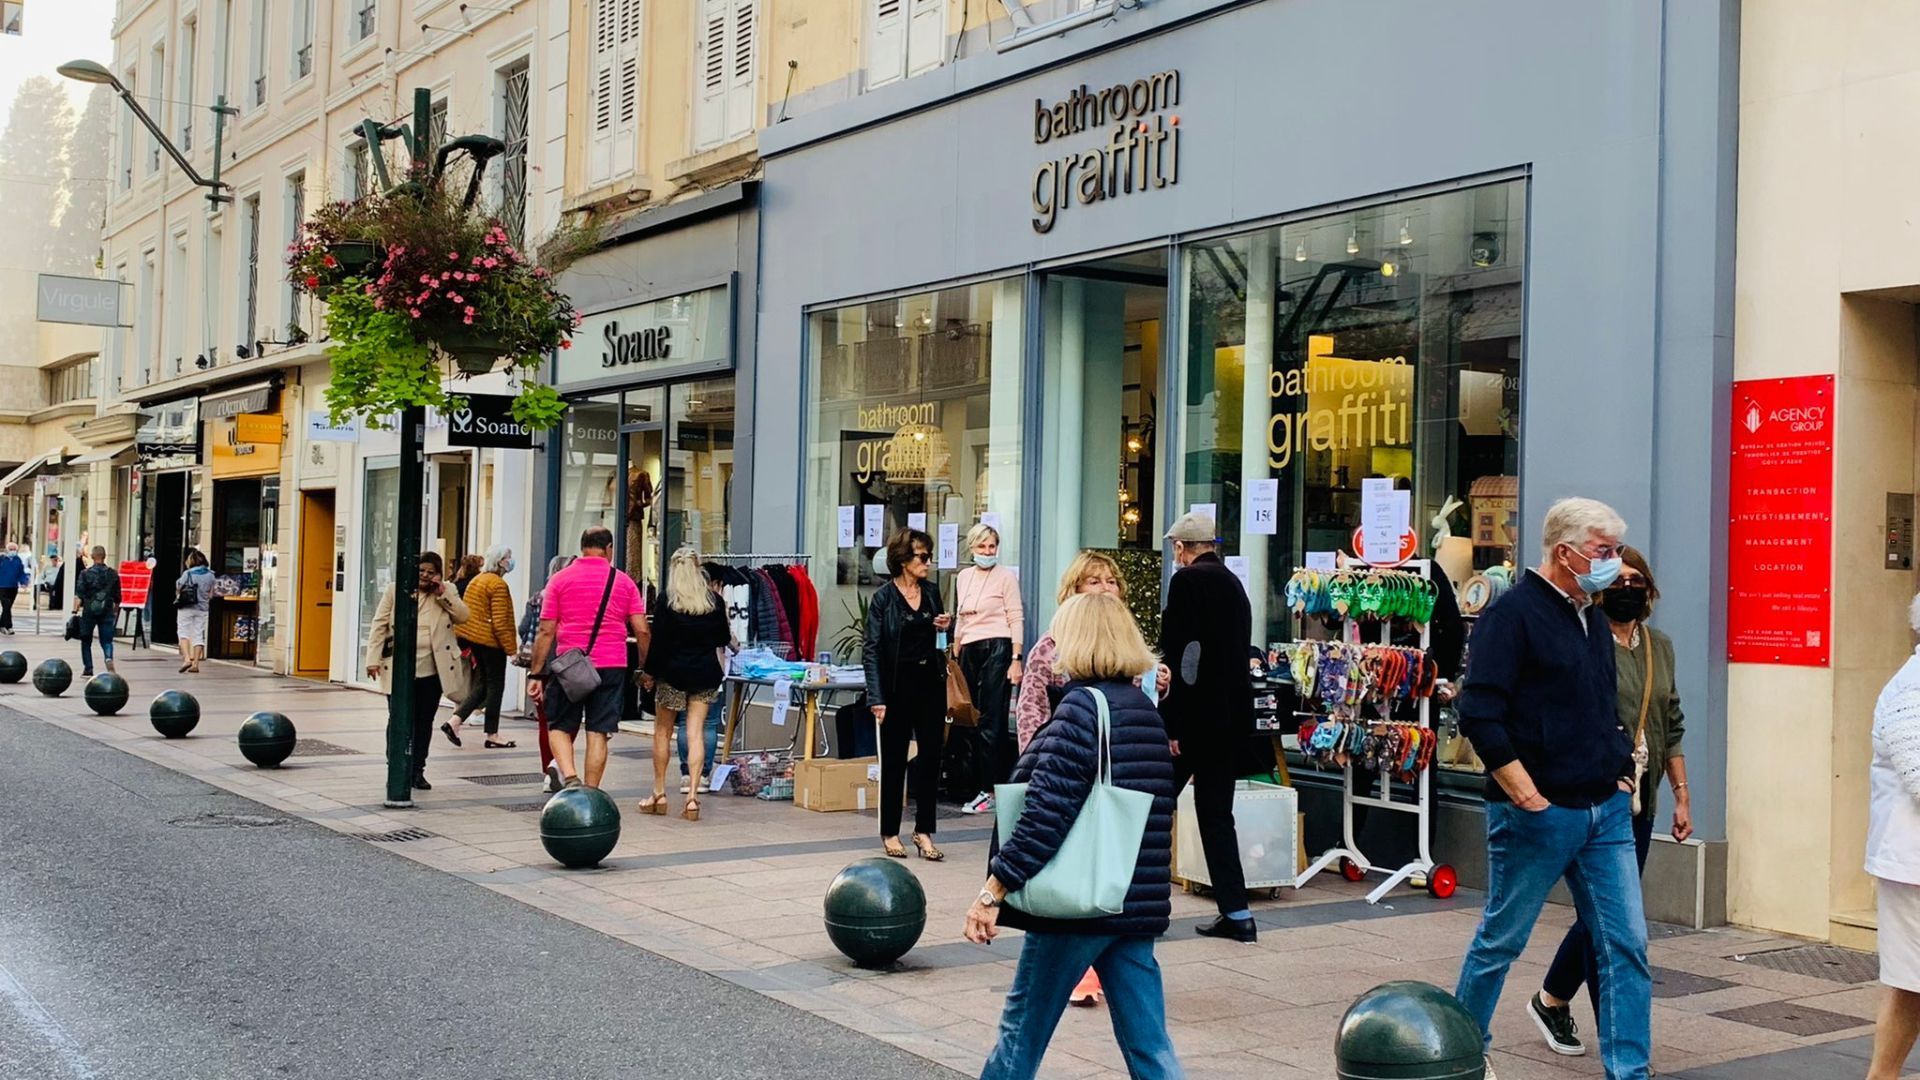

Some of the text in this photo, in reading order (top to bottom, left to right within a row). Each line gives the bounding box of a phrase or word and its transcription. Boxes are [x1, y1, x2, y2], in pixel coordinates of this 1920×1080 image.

[1035, 69, 1179, 144] bathroom
[1032, 115, 1181, 233] graffiti
[42, 286, 114, 313] Virgule
[602, 321, 671, 368] Soane
[1268, 355, 1406, 398] bathroom
[858, 401, 934, 429] bathroom
[1769, 406, 1826, 422] AGENCY
[476, 417, 530, 436] Soane
[1267, 389, 1407, 470] graffiti
[1790, 421, 1824, 432] GROUP
[1747, 487, 1817, 496] TRANSACTION
[1738, 512, 1824, 521] INVESTISSEMENT
[1745, 538, 1813, 546] MANAGEMENT
[1754, 563, 1804, 571] LOCATION
